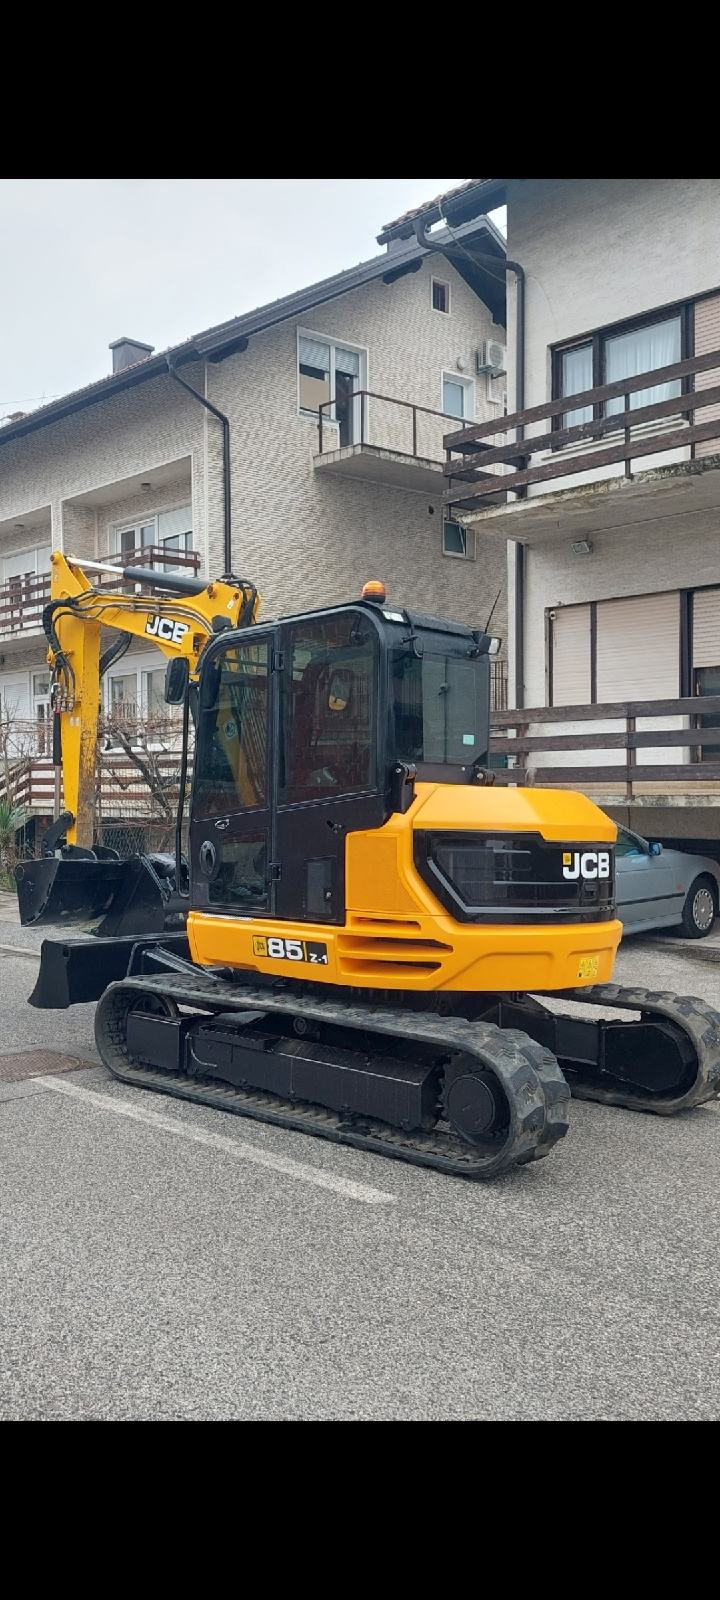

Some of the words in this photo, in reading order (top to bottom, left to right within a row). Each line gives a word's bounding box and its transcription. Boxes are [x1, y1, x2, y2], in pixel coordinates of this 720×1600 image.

[146, 615, 189, 644] JCB
[562, 852, 610, 879] JCB
[267, 938, 303, 960] 85
